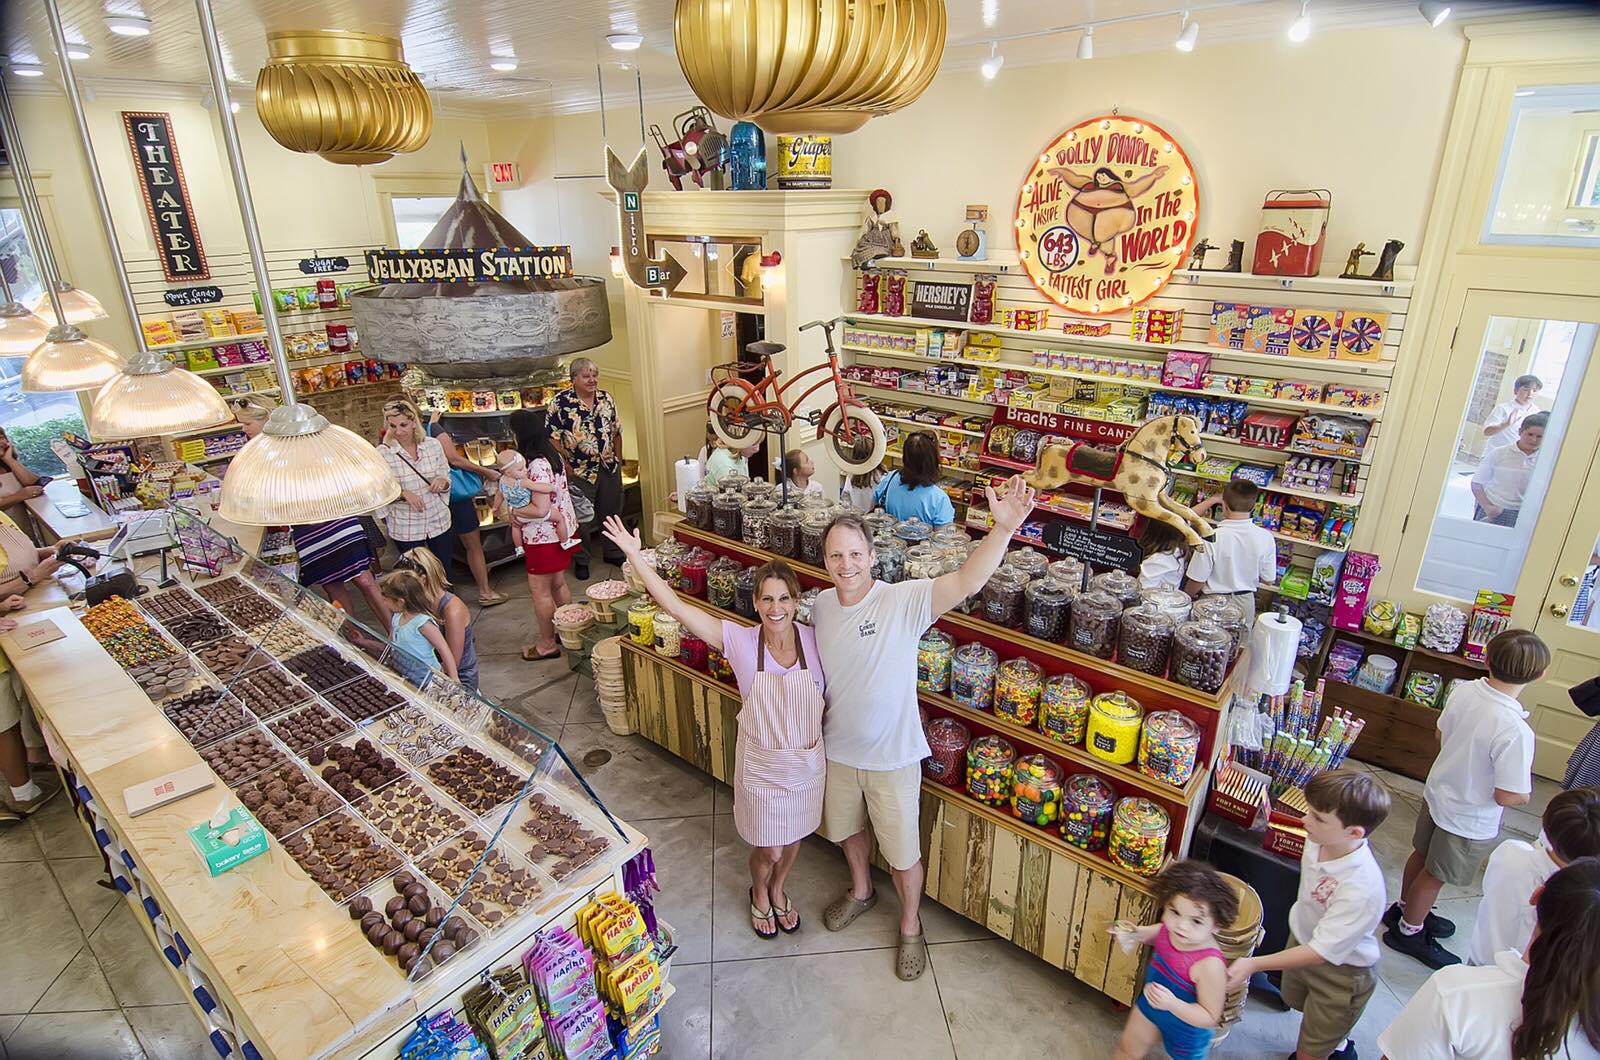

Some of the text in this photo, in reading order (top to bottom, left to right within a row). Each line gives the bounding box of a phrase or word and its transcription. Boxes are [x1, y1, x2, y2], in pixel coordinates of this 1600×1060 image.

[1056, 133, 1159, 167] DOLLY DIMPLE
[492, 163, 514, 183] EXIT
[137, 122, 197, 272] THEATER
[1024, 178, 1063, 215] ALIVE
[1136, 191, 1182, 226] In The
[626, 196, 638, 256] Nitro
[1033, 205, 1060, 231] INSIDE
[1043, 232, 1074, 255] 643
[1121, 220, 1187, 264] WORLD
[370, 252, 566, 279] JELLYBEAN STATION
[1046, 253, 1069, 268] LBS.
[648, 269, 670, 282] Bar
[1048, 272, 1130, 301] FATTEST GIRL
[191, 289, 216, 299] Candy
[916, 284, 968, 305] HERSHEY'S
[1006, 408, 1136, 440] Brach's FINE CAND
[859, 623, 876, 631] CANDY
[215, 853, 241, 868] bakery
[606, 911, 636, 940] HARIBO
[553, 957, 585, 980] HARIBO
[624, 966, 654, 997] HARIBO
